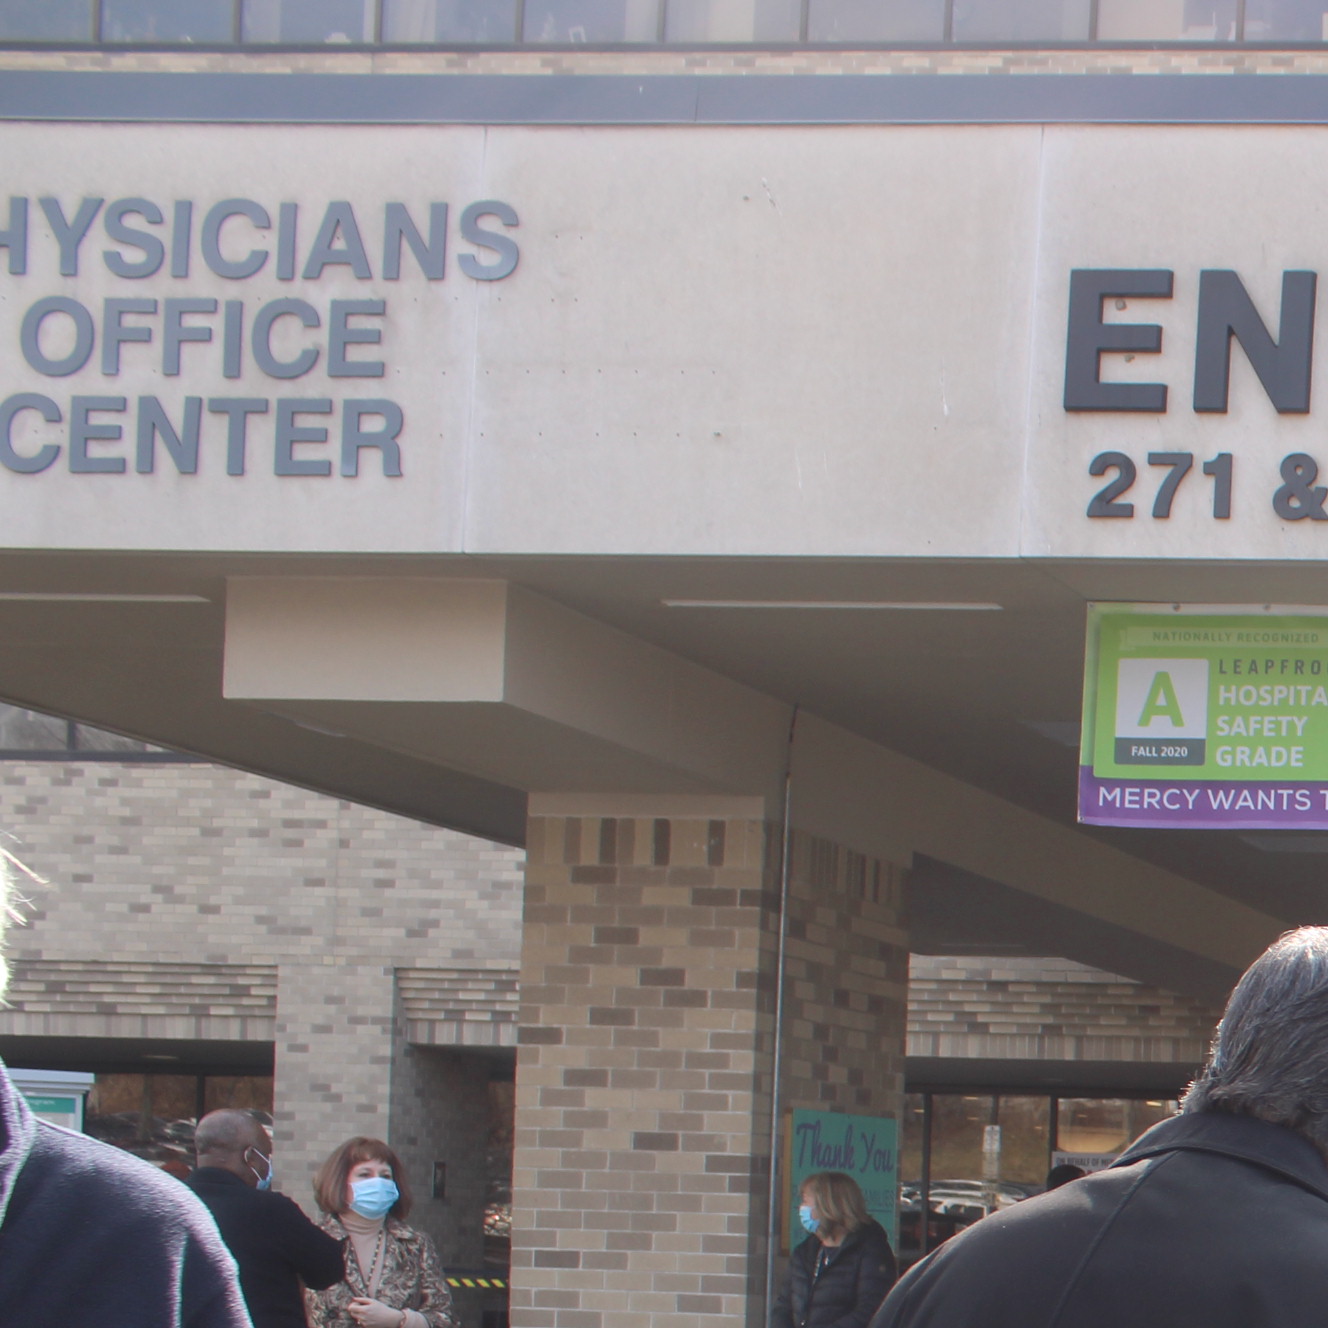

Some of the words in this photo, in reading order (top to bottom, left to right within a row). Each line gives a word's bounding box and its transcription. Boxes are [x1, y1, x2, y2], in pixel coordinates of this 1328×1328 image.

[20, 296, 386, 379] OFFICE
[0, 393, 404, 478] CENTER
[1087, 451, 1233, 519] 271
[1152, 631, 1233, 642] NATIONALLY
[1237, 632, 1319, 643] RECOGNIZED
[1137, 671, 1185, 727] A
[1216, 716, 1308, 736] SAFETY
[1131, 746, 1159, 757] FALL
[1161, 746, 1188, 758] 2020
[1215, 746, 1304, 767] GRADE
[1098, 786, 1200, 810] MERCY
[1207, 789, 1312, 811] WANTS
[796, 1121, 855, 1170] Thank
[859, 1131, 894, 1173] You
